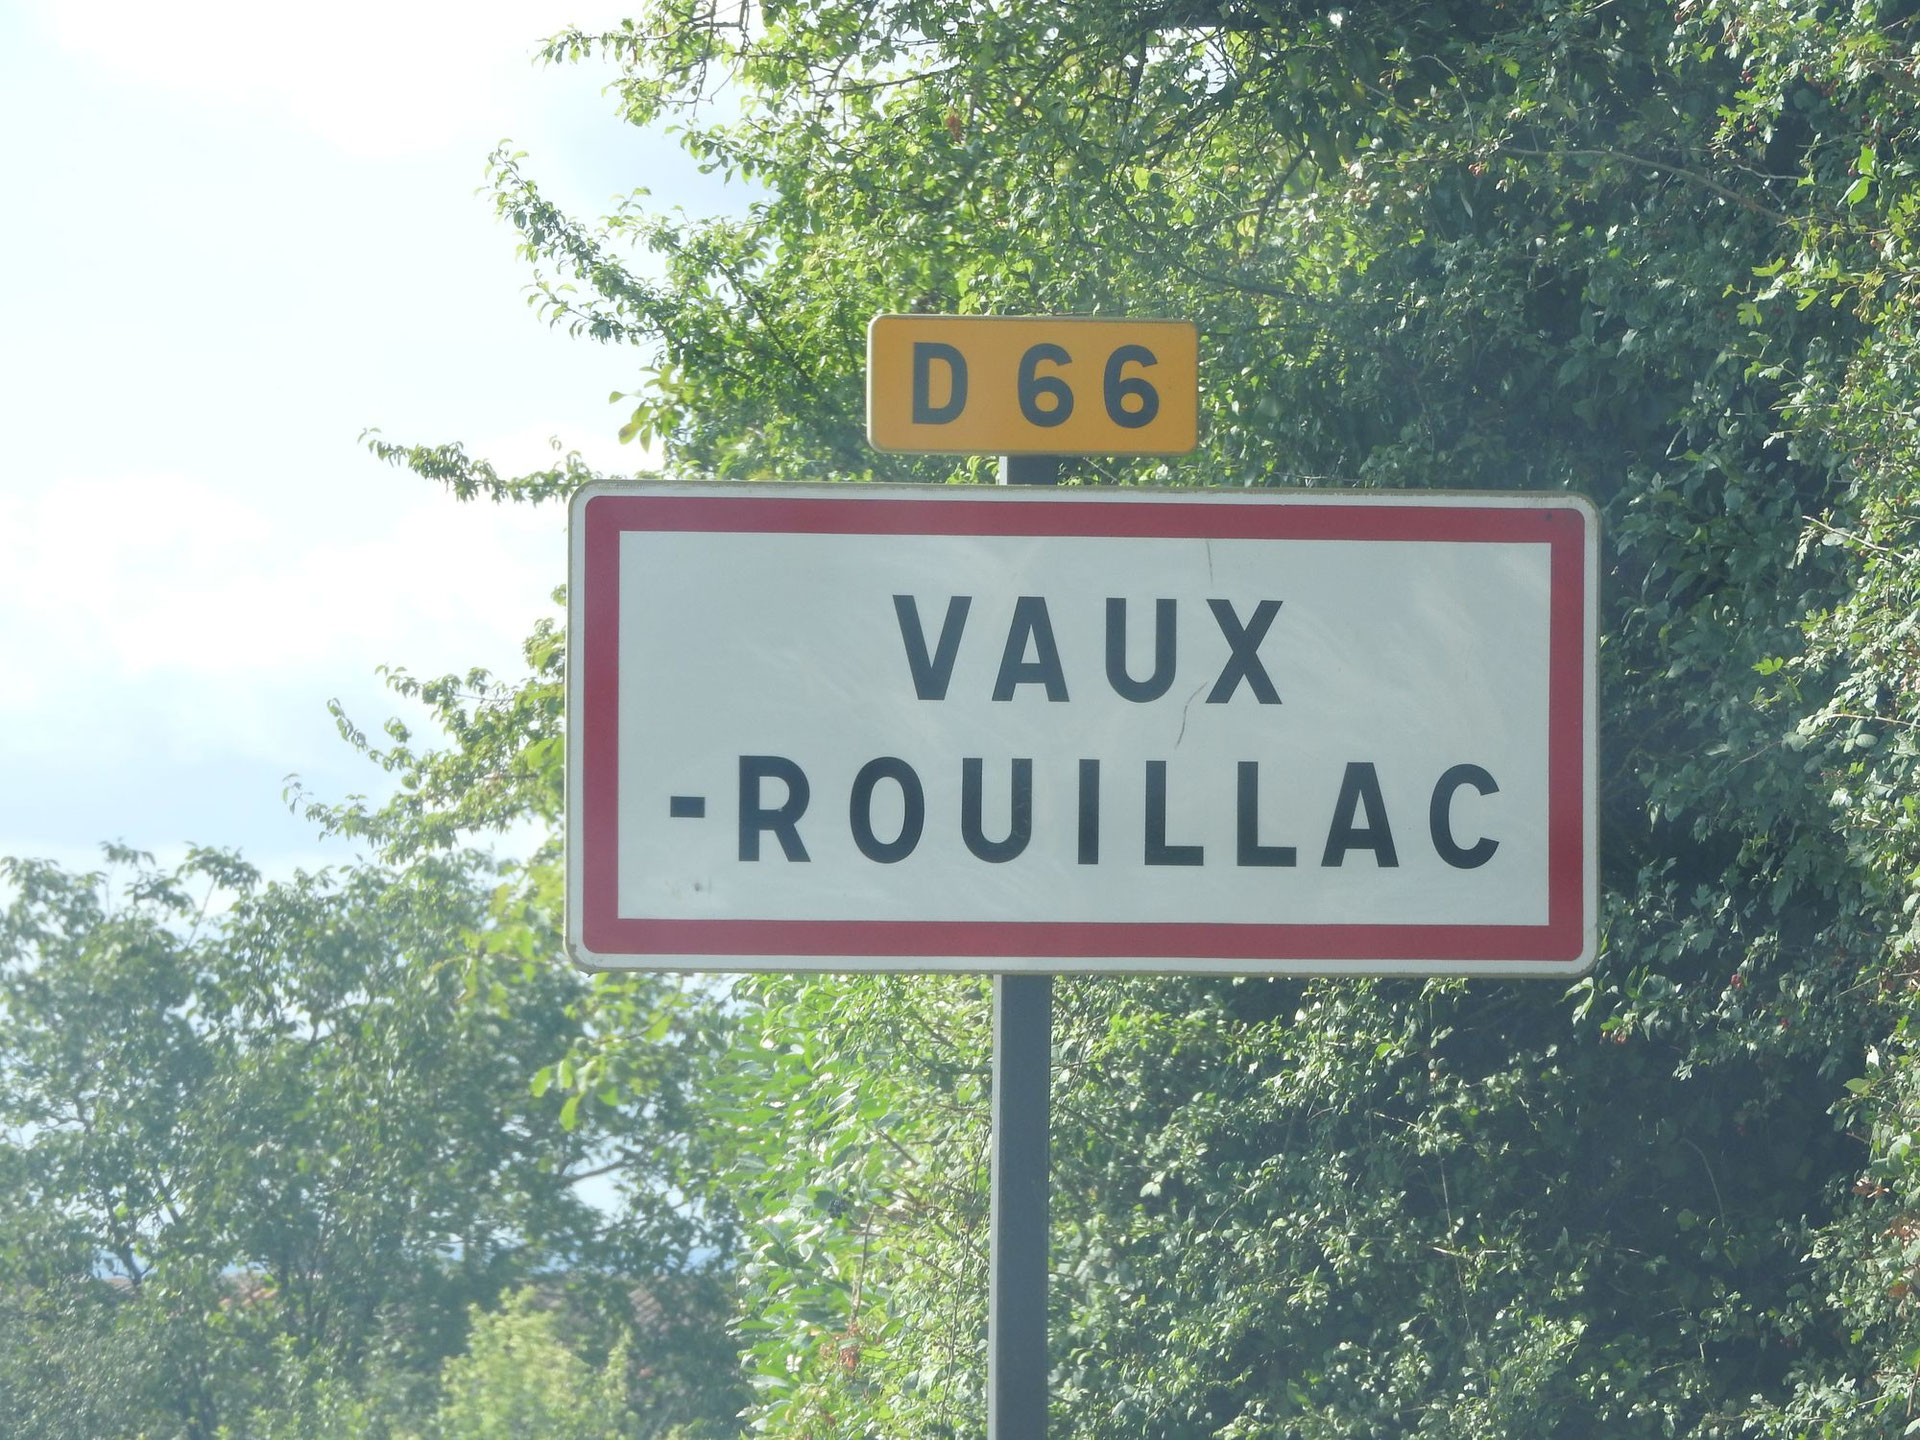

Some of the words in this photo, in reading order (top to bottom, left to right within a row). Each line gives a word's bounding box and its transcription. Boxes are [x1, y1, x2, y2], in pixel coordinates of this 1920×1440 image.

[912, 341, 969, 425] D
[1017, 343, 1160, 429] 66
[892, 594, 1284, 705] VAUX
